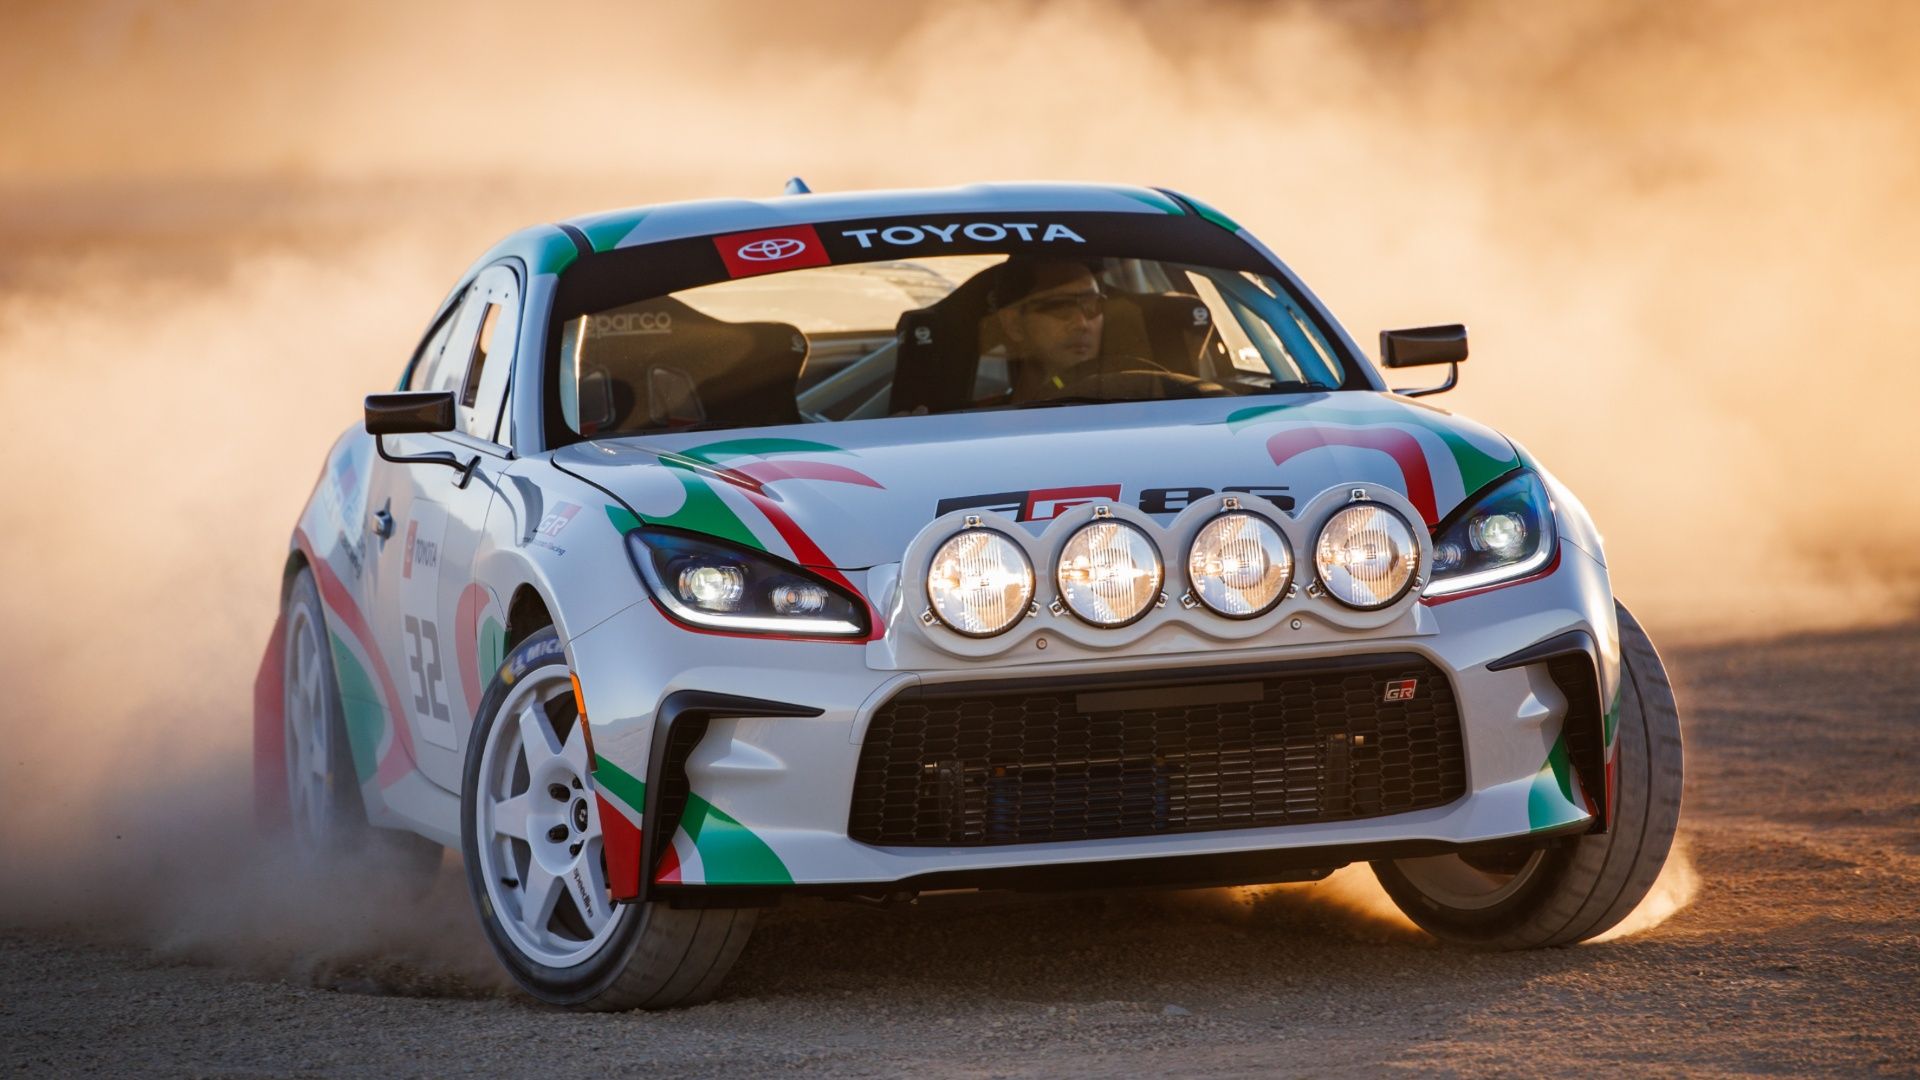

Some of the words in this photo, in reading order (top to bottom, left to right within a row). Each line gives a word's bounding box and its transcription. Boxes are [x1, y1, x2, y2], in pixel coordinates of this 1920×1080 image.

[842, 223, 1087, 248] TOYOTA
[415, 539, 438, 568] TOYOTA
[404, 614, 450, 723] 32
[1385, 685, 1414, 700] GR
